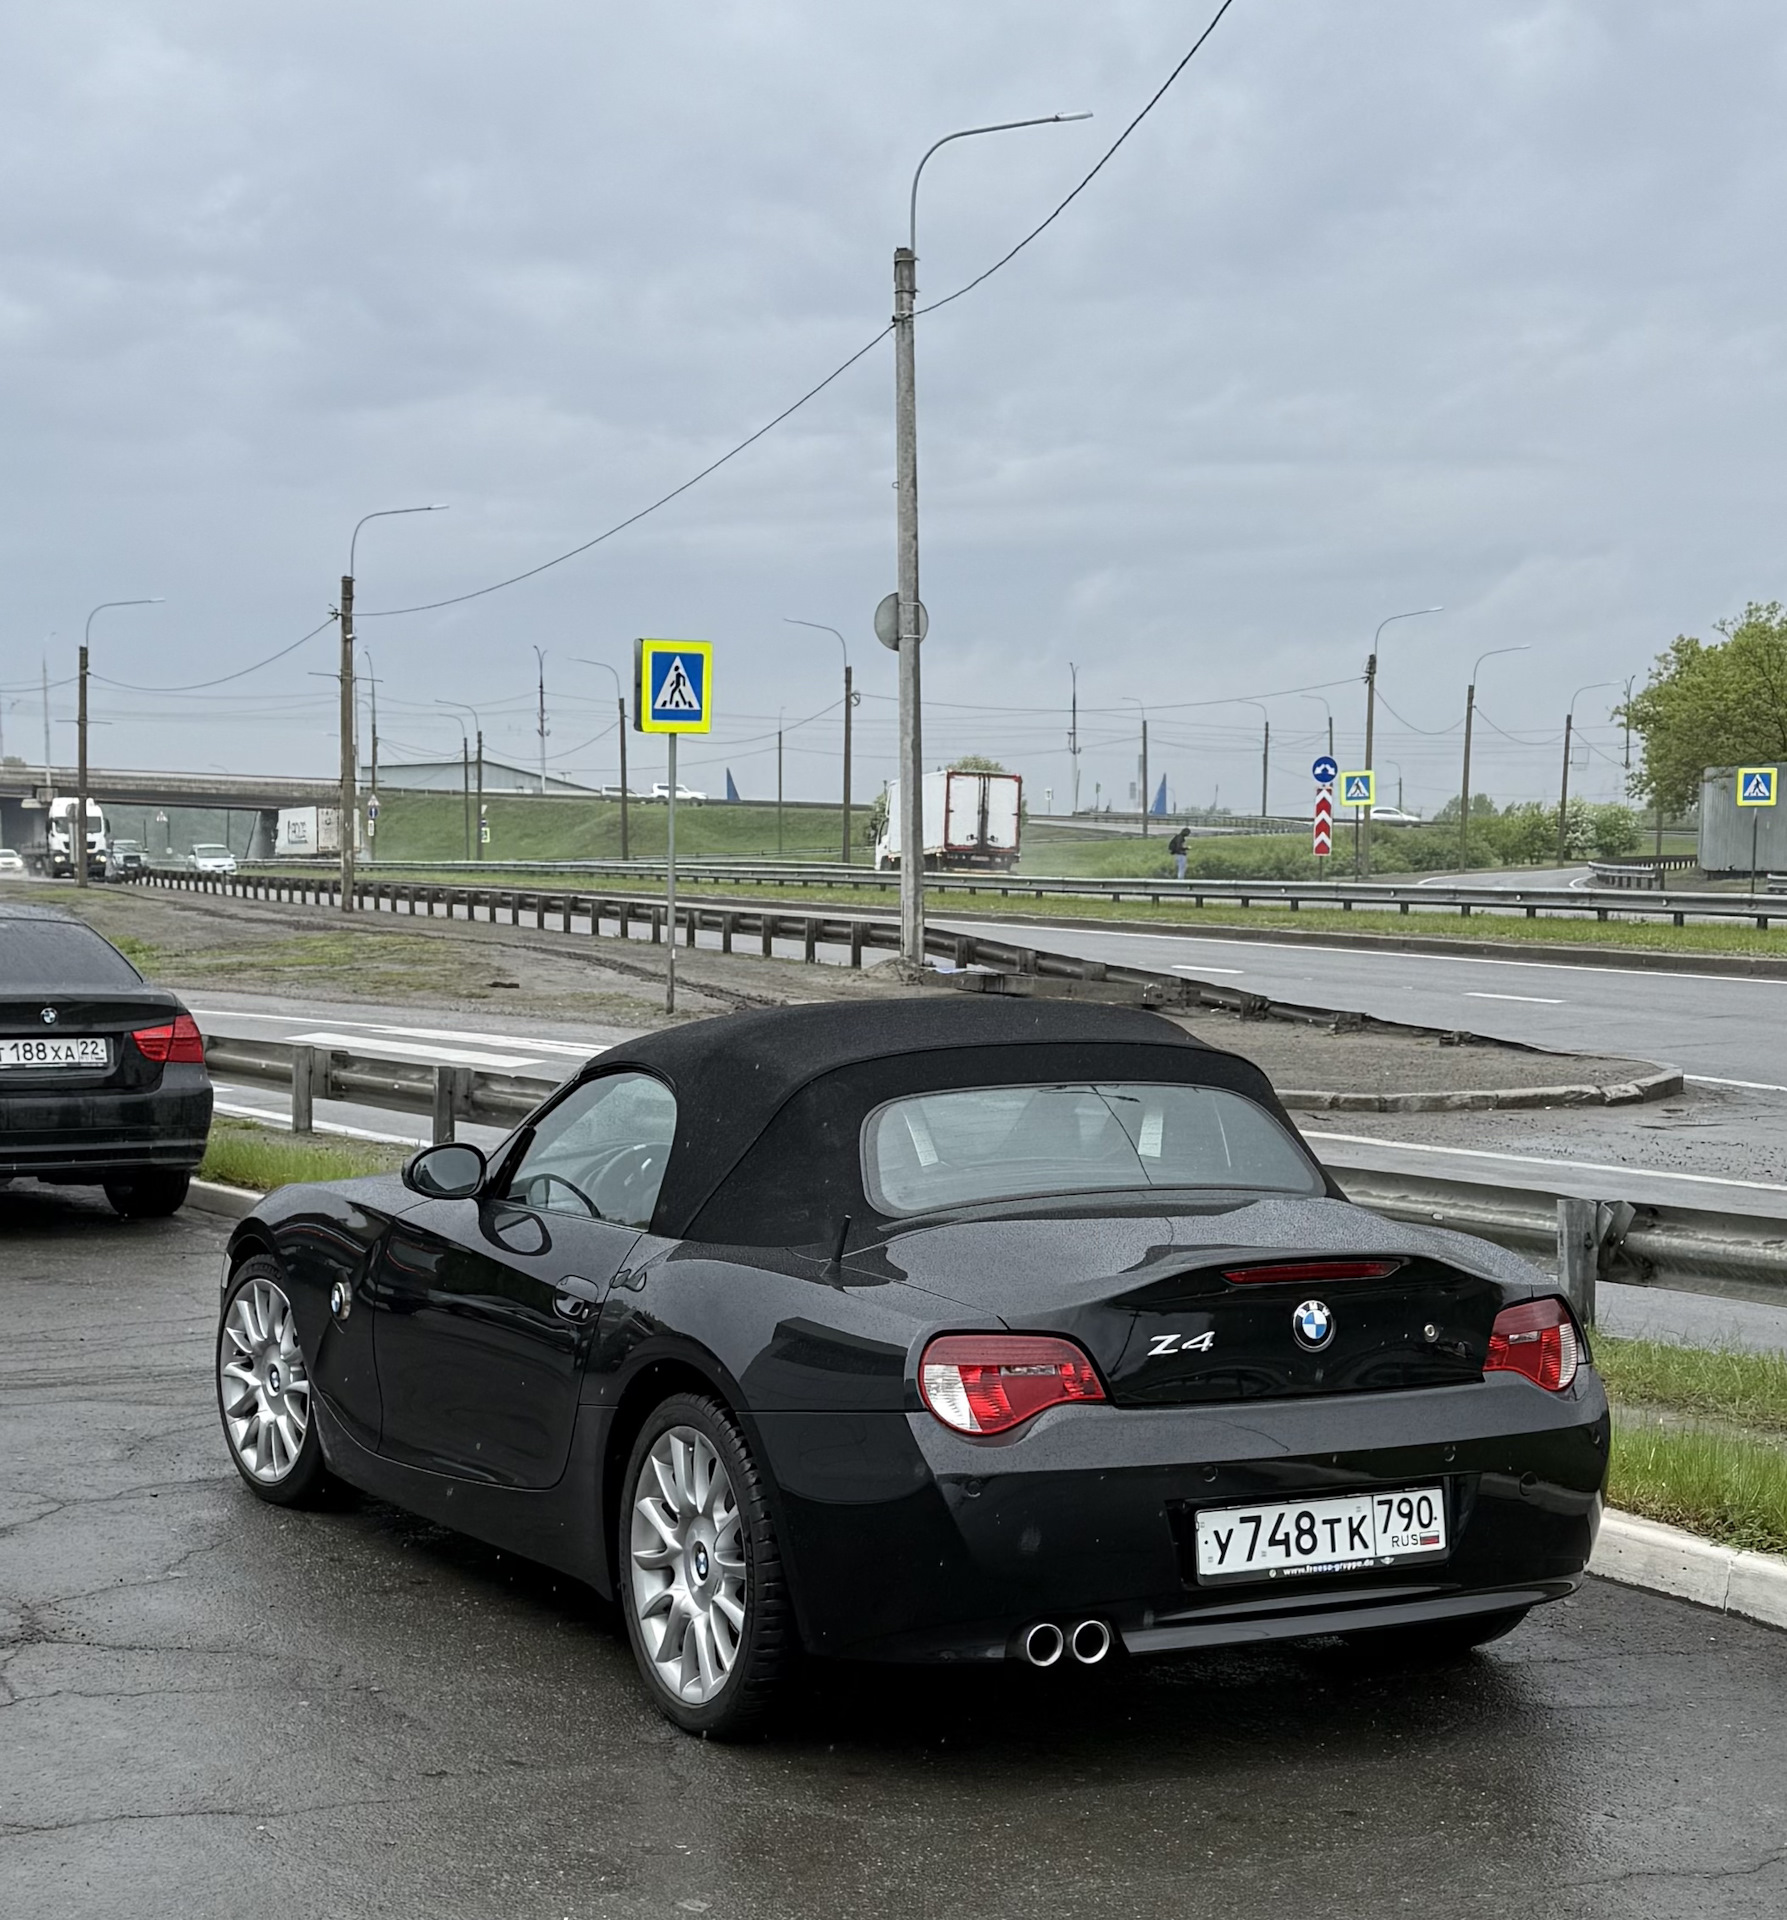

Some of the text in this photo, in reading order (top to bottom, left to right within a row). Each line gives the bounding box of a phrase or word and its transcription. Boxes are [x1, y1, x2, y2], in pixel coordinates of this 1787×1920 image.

[80, 1041, 99, 1055] 22
[1147, 1331, 1215, 1357] Z4
[1377, 1495, 1433, 1535] 790
[1392, 1533, 1419, 1548] RUS
